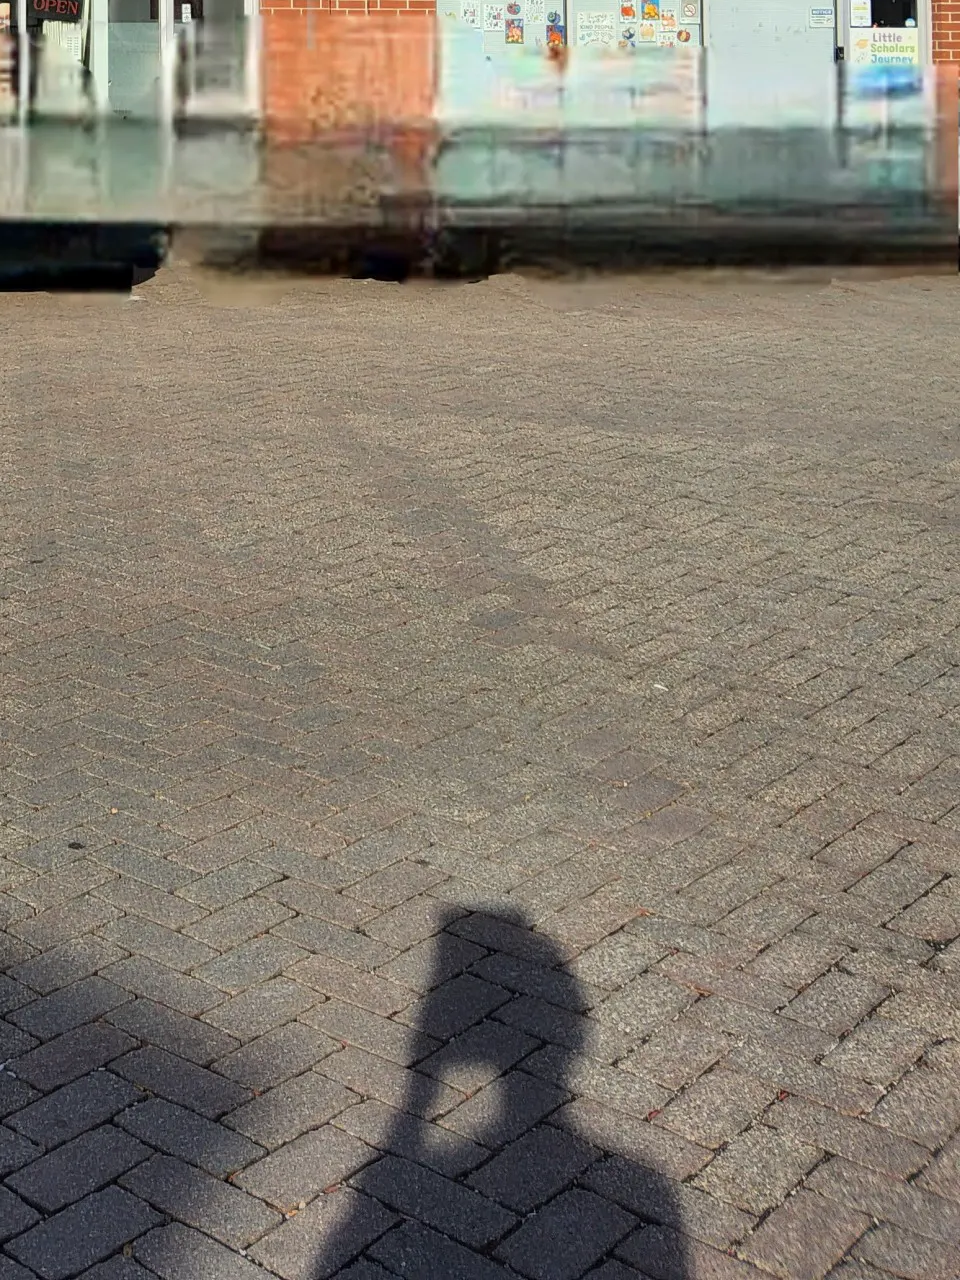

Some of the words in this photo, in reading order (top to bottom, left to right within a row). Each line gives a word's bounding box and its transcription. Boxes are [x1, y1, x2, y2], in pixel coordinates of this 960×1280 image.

[873, 33, 902, 43] Little
[871, 43, 915, 53] Scholars
[871, 54, 914, 65] Journey
